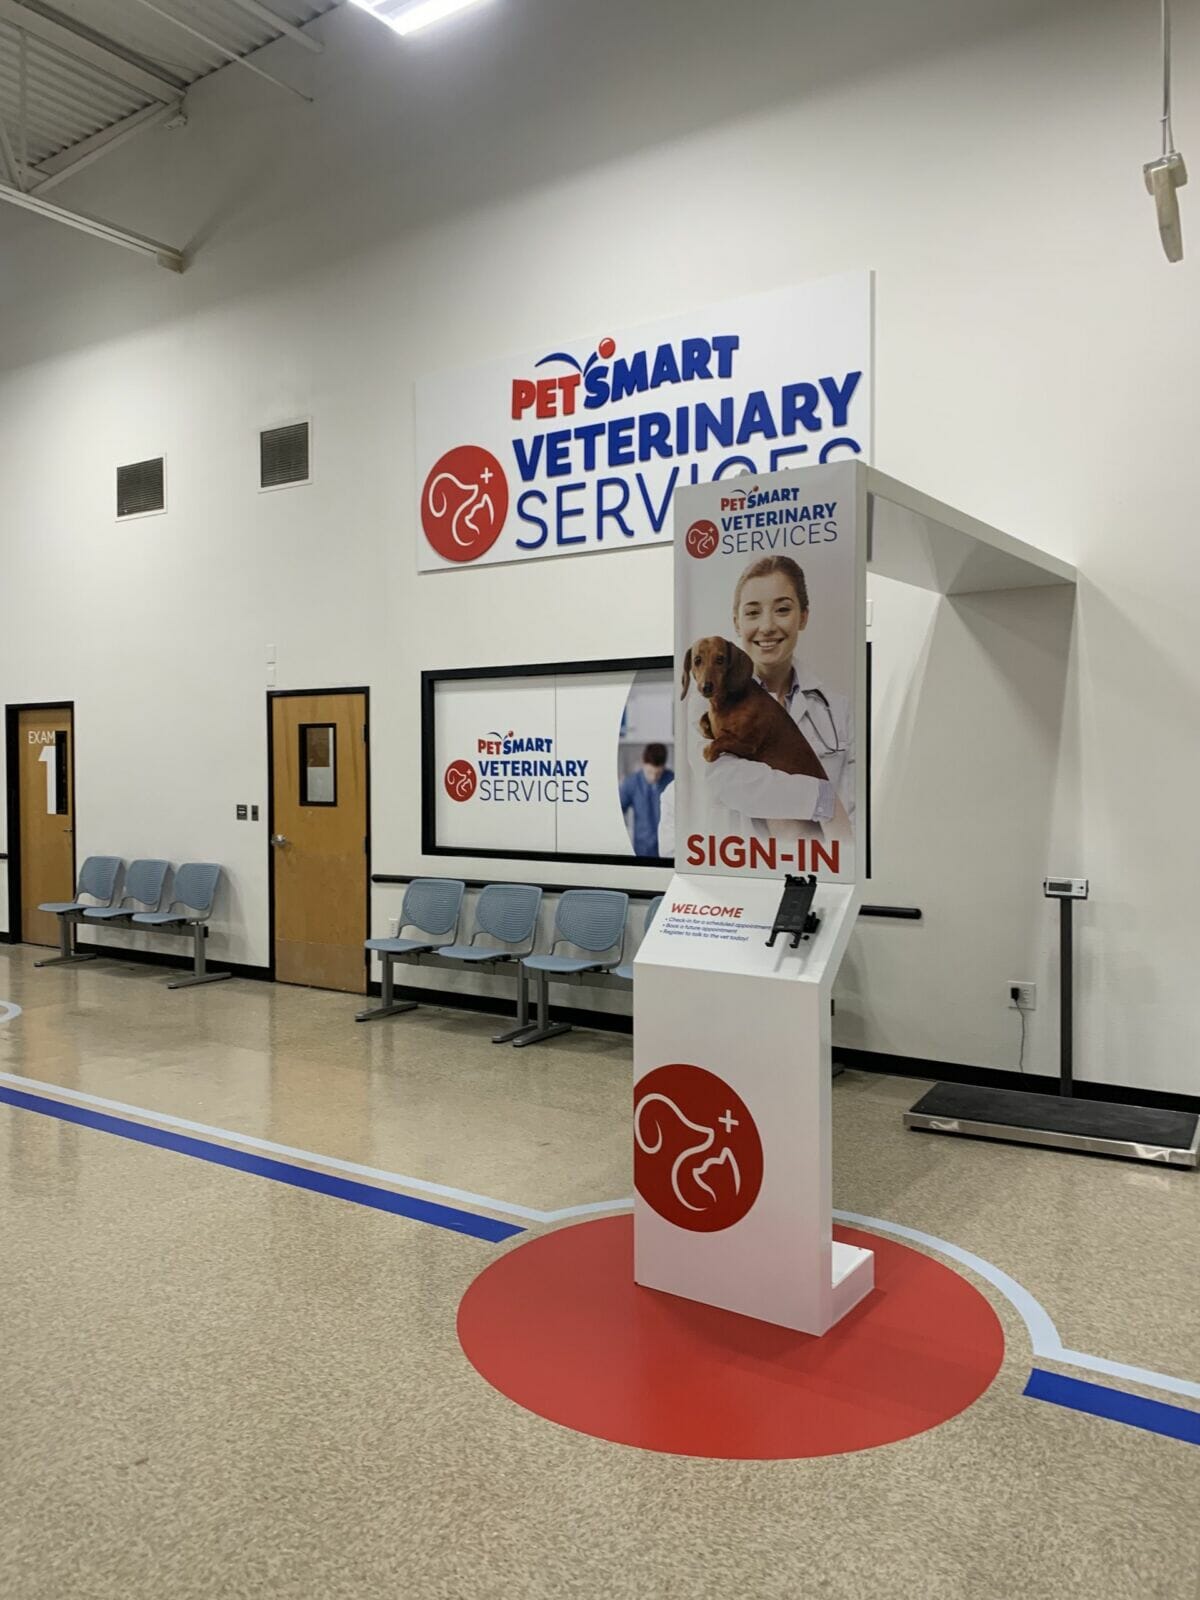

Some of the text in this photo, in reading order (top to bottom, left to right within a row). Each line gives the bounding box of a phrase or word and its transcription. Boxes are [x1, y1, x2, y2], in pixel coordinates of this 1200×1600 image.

[511, 335, 740, 420] PETSMART
[512, 371, 862, 481] VETERINARY
[720, 487, 800, 512] PETSMART
[721, 502, 837, 532] VETERINARY
[721, 521, 838, 555] SERVICES
[28, 730, 56, 744] EXAM
[478, 737, 553, 755] PETSMART
[38, 745, 57, 814] 1
[478, 760, 589, 777] VETERINARY
[479, 779, 590, 803] SERVICES
[686, 834, 840, 874] SIGN-IN
[671, 903, 744, 918] WELCOME
